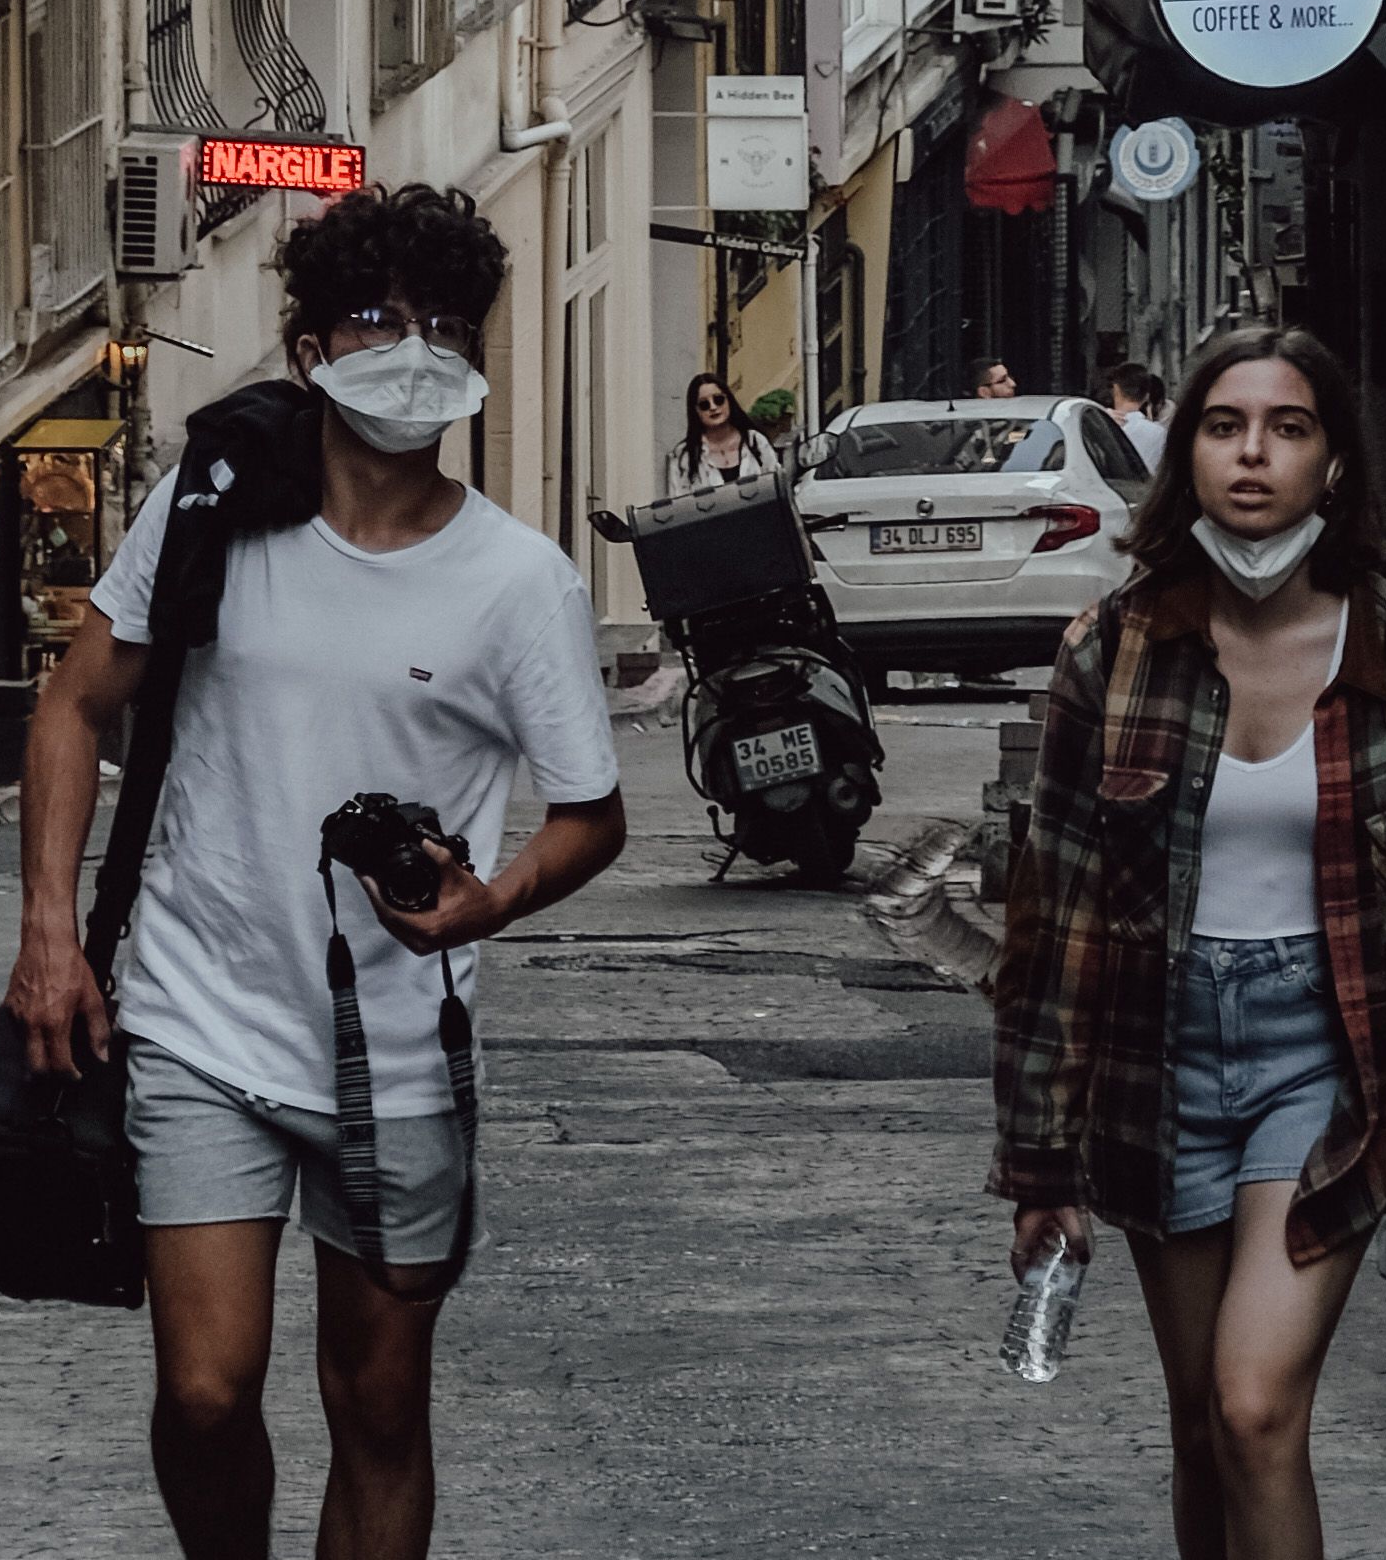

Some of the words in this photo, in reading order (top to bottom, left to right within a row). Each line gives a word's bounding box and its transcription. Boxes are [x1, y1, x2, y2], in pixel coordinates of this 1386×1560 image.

[1192, 5, 1260, 32] COFFEE
[1269, 4, 1283, 29] &
[715, 90, 724, 99] A
[727, 89, 770, 100] Hidden
[773, 90, 795, 100] Bee
[703, 233, 713, 244] A
[716, 234, 759, 251] Hidden
[761, 241, 805, 259] Gallery
[882, 528, 902, 546] 34
[908, 527, 939, 545] DLJ
[946, 526, 976, 544] 695
[737, 738, 766, 760] 34
[780, 727, 812, 750] ME
[756, 747, 814, 777] 0585
